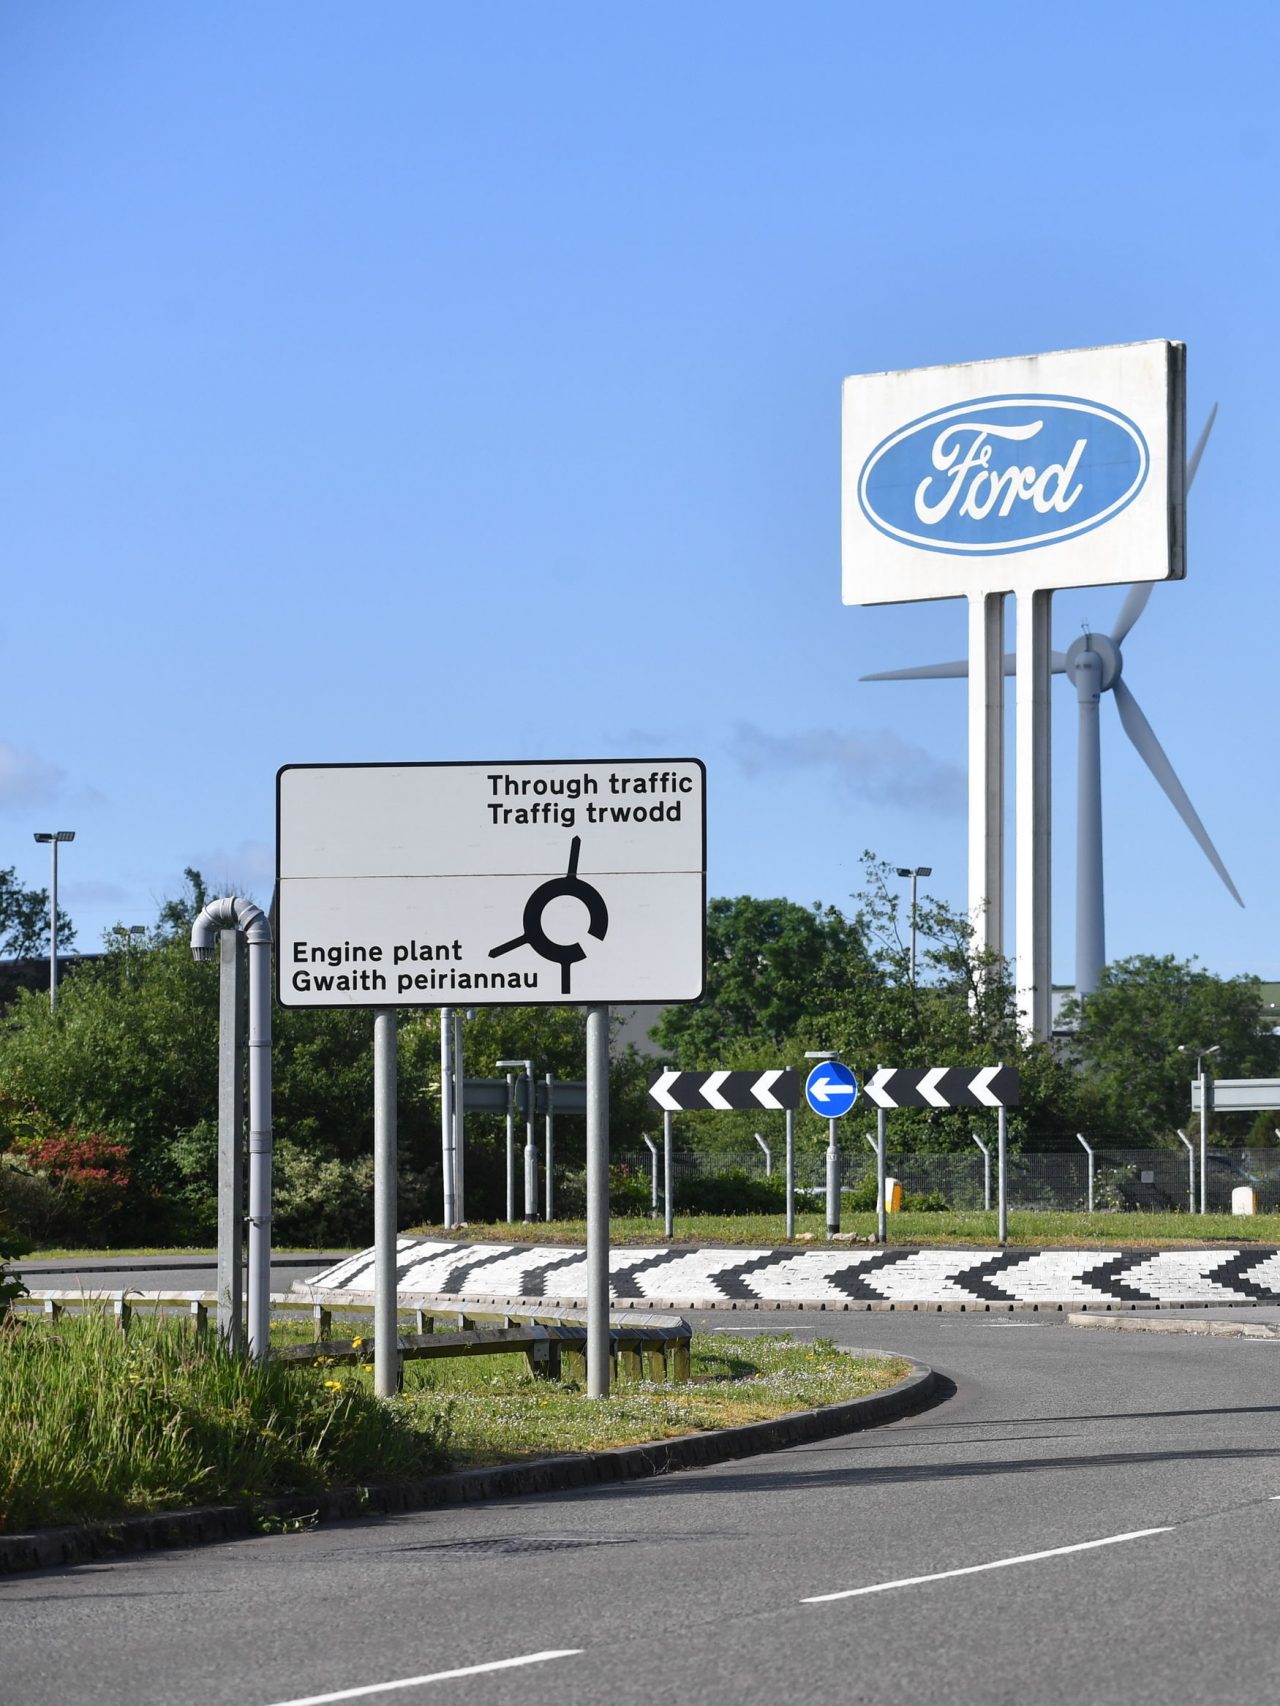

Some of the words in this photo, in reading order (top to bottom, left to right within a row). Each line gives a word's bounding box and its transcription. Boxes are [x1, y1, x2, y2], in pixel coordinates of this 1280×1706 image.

[914, 420, 1088, 525] Ford
[487, 773, 598, 799] Through
[608, 771, 693, 795] traffic
[487, 803, 575, 828] Traffig
[586, 800, 681, 824] trwodd
[293, 941, 383, 967] Engine
[393, 939, 463, 966] plant
[292, 969, 387, 992] Gwaith
[397, 968, 538, 994] peiriannau
